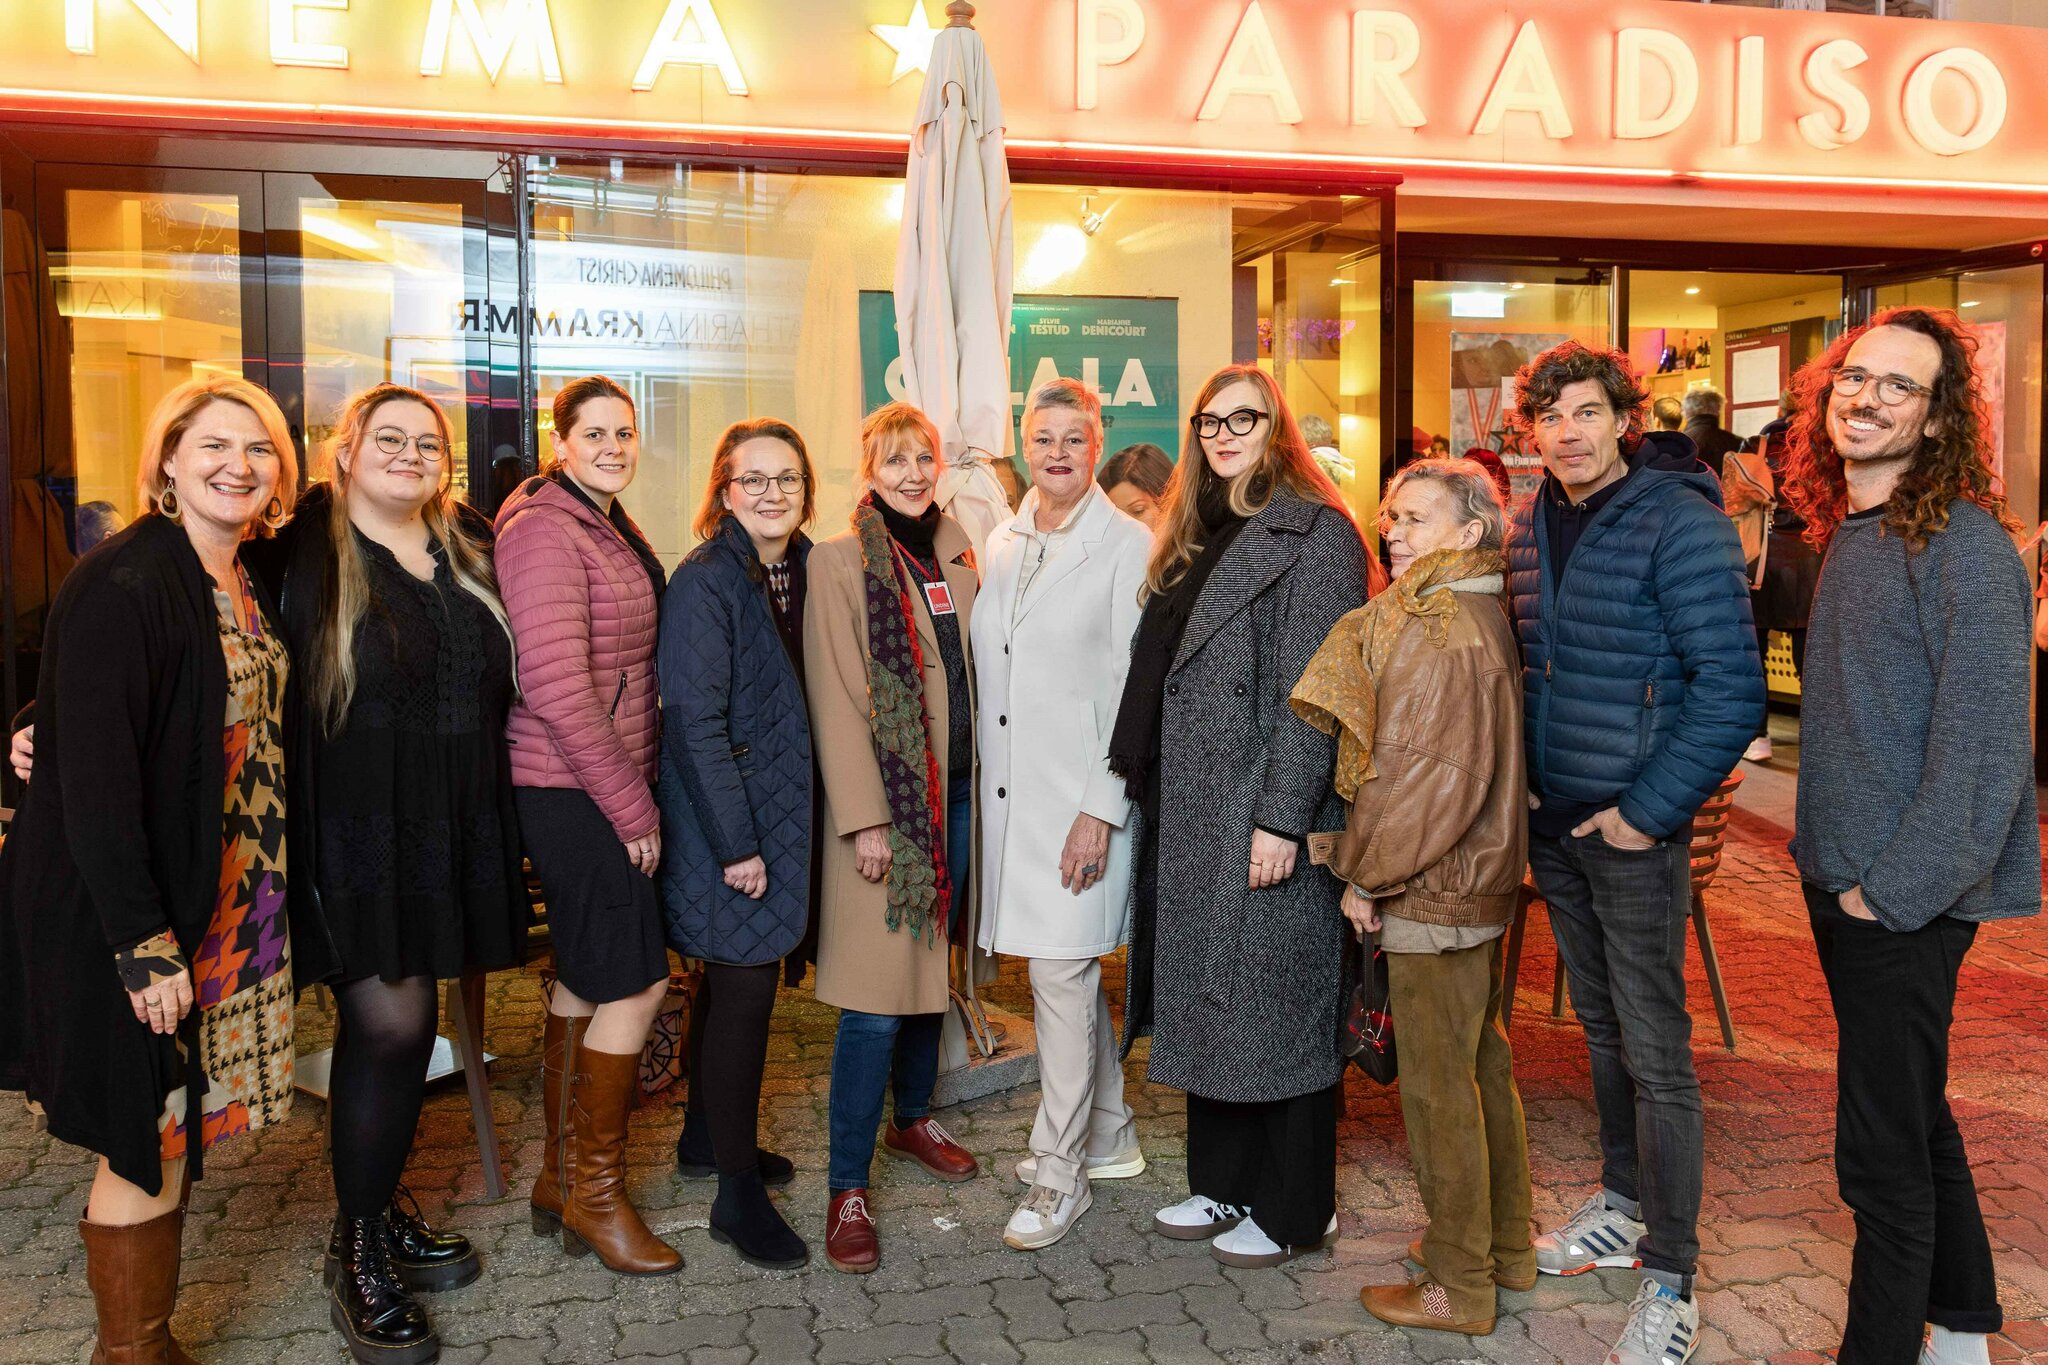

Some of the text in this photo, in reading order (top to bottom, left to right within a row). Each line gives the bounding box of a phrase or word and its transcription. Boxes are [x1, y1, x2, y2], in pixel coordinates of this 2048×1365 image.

[1075, 0, 2007, 156] PARADISO
[1029, 324, 1070, 335] TESTUD
[1081, 326, 1147, 337] DENICOURT
